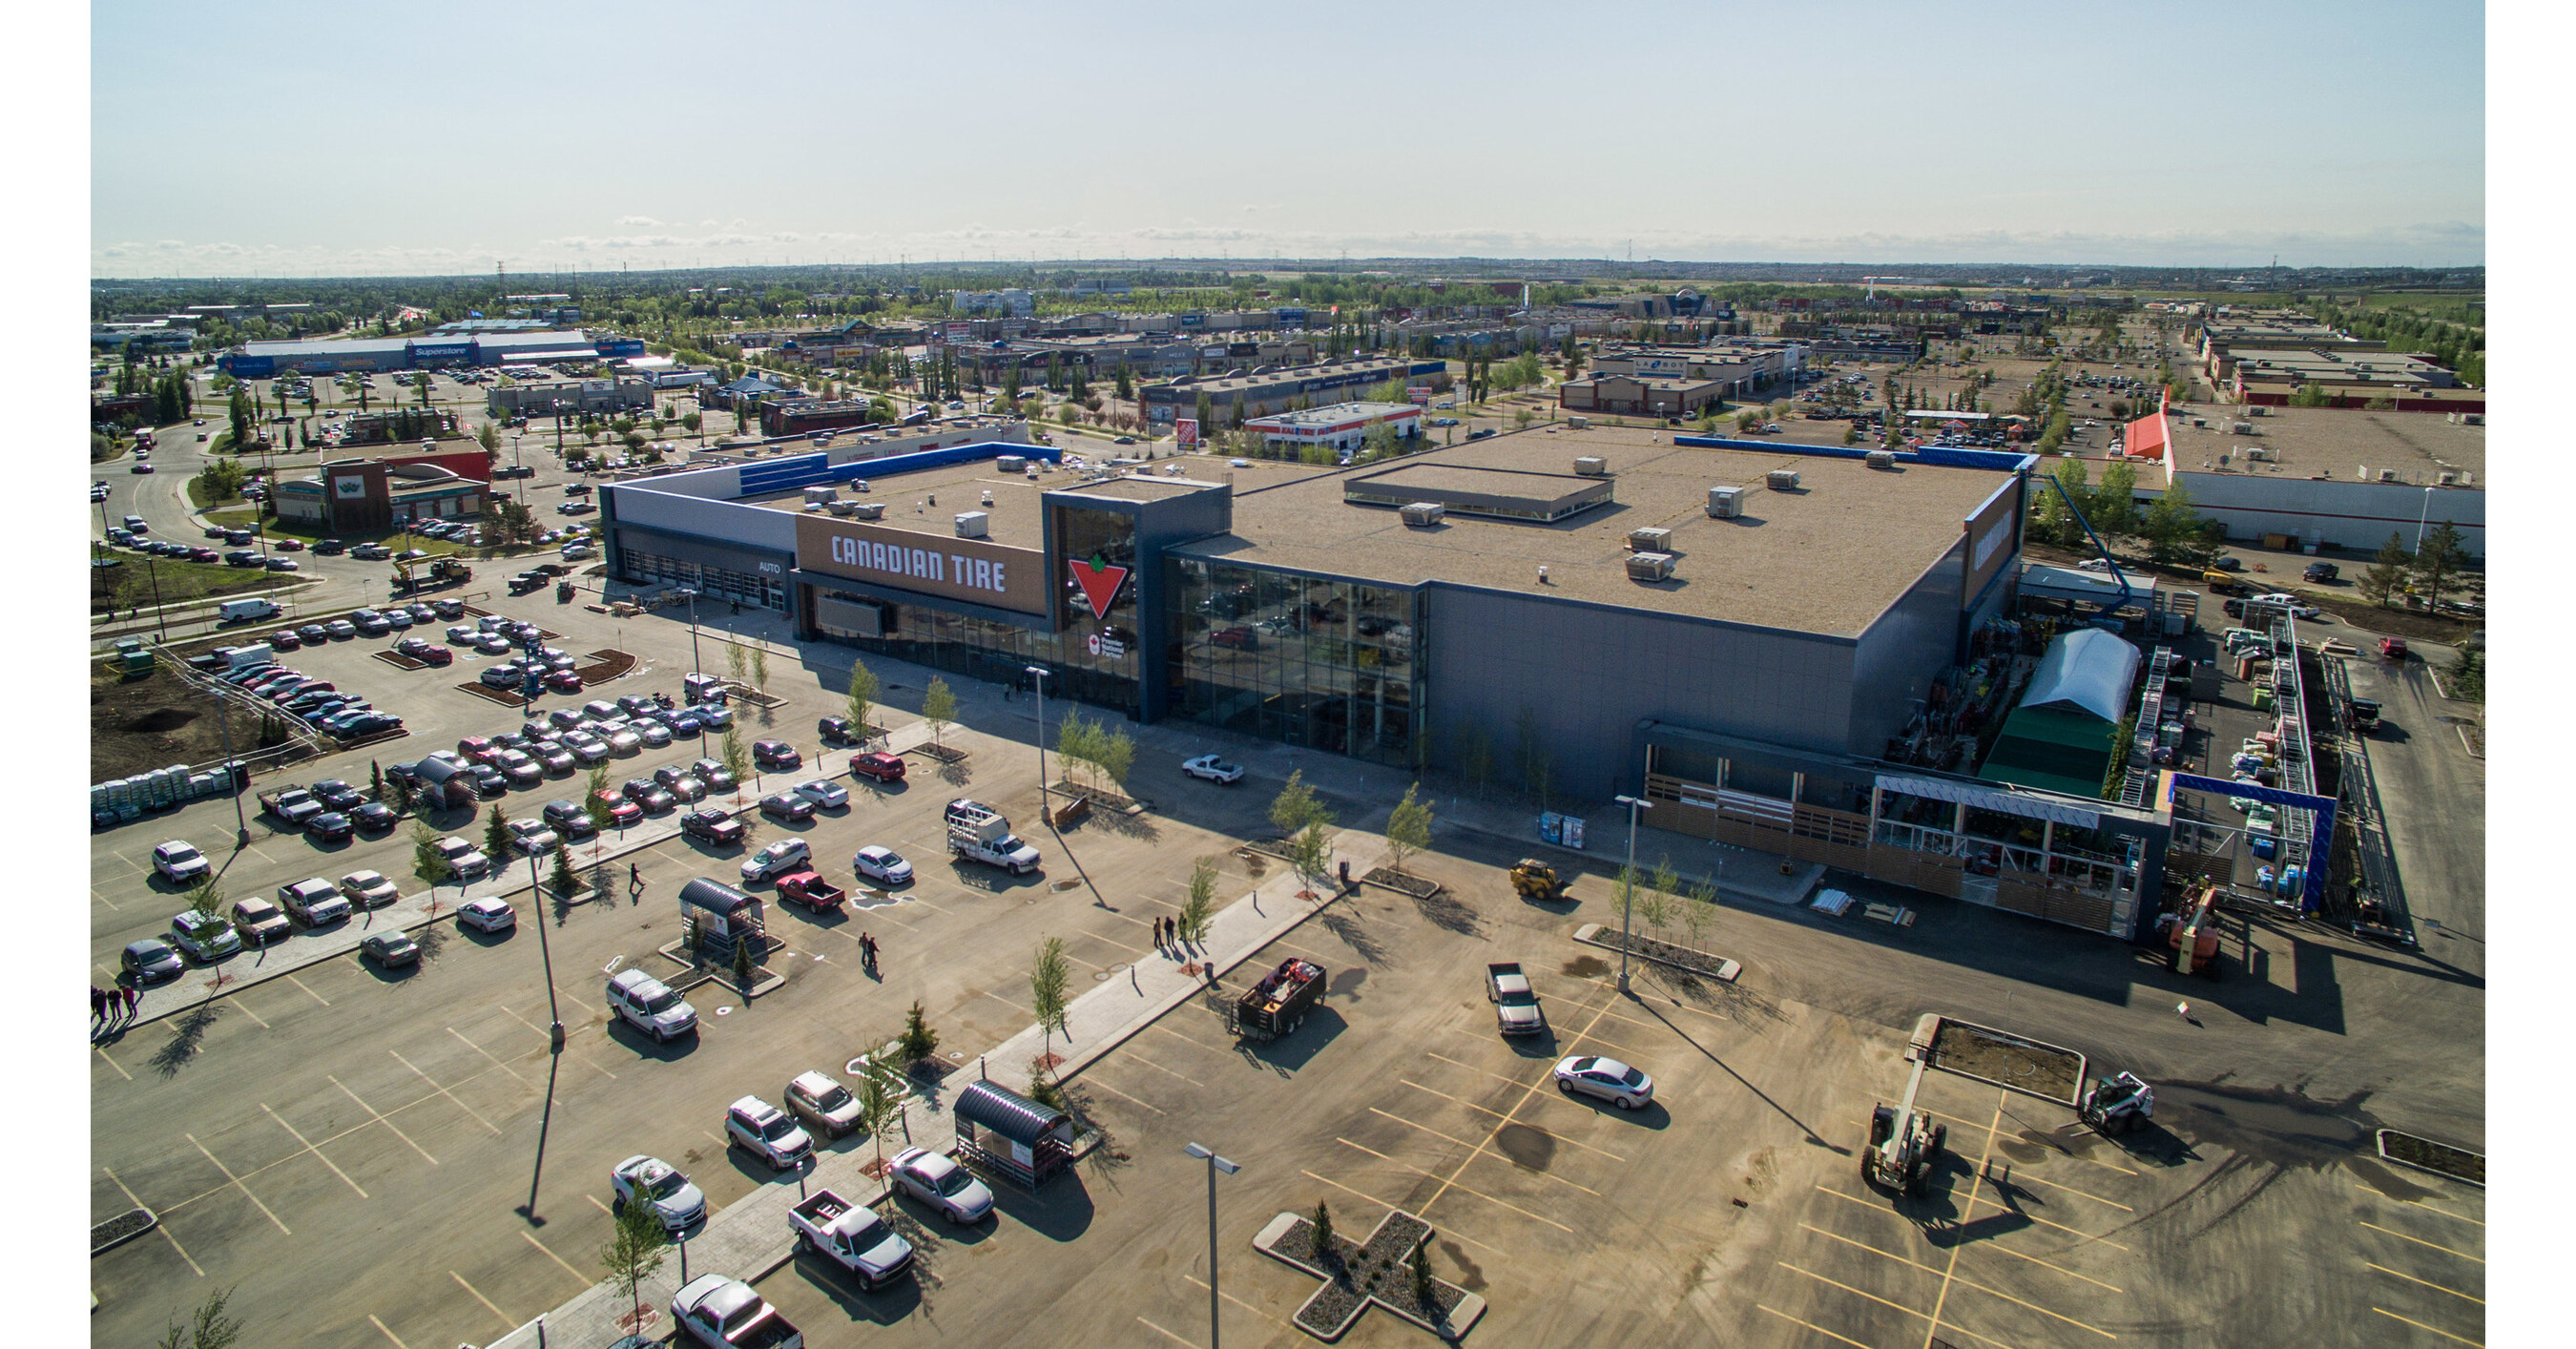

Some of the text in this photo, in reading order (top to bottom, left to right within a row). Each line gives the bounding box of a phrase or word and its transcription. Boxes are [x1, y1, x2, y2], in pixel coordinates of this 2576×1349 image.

[415, 347, 467, 357] Superstore
[758, 561, 780, 573] AUTO
[831, 535, 1007, 592] CANADIAN TIRE
[1101, 636, 1124, 648] Premier
[1101, 643, 1125, 654] National
[1101, 650, 1123, 659] Partner
